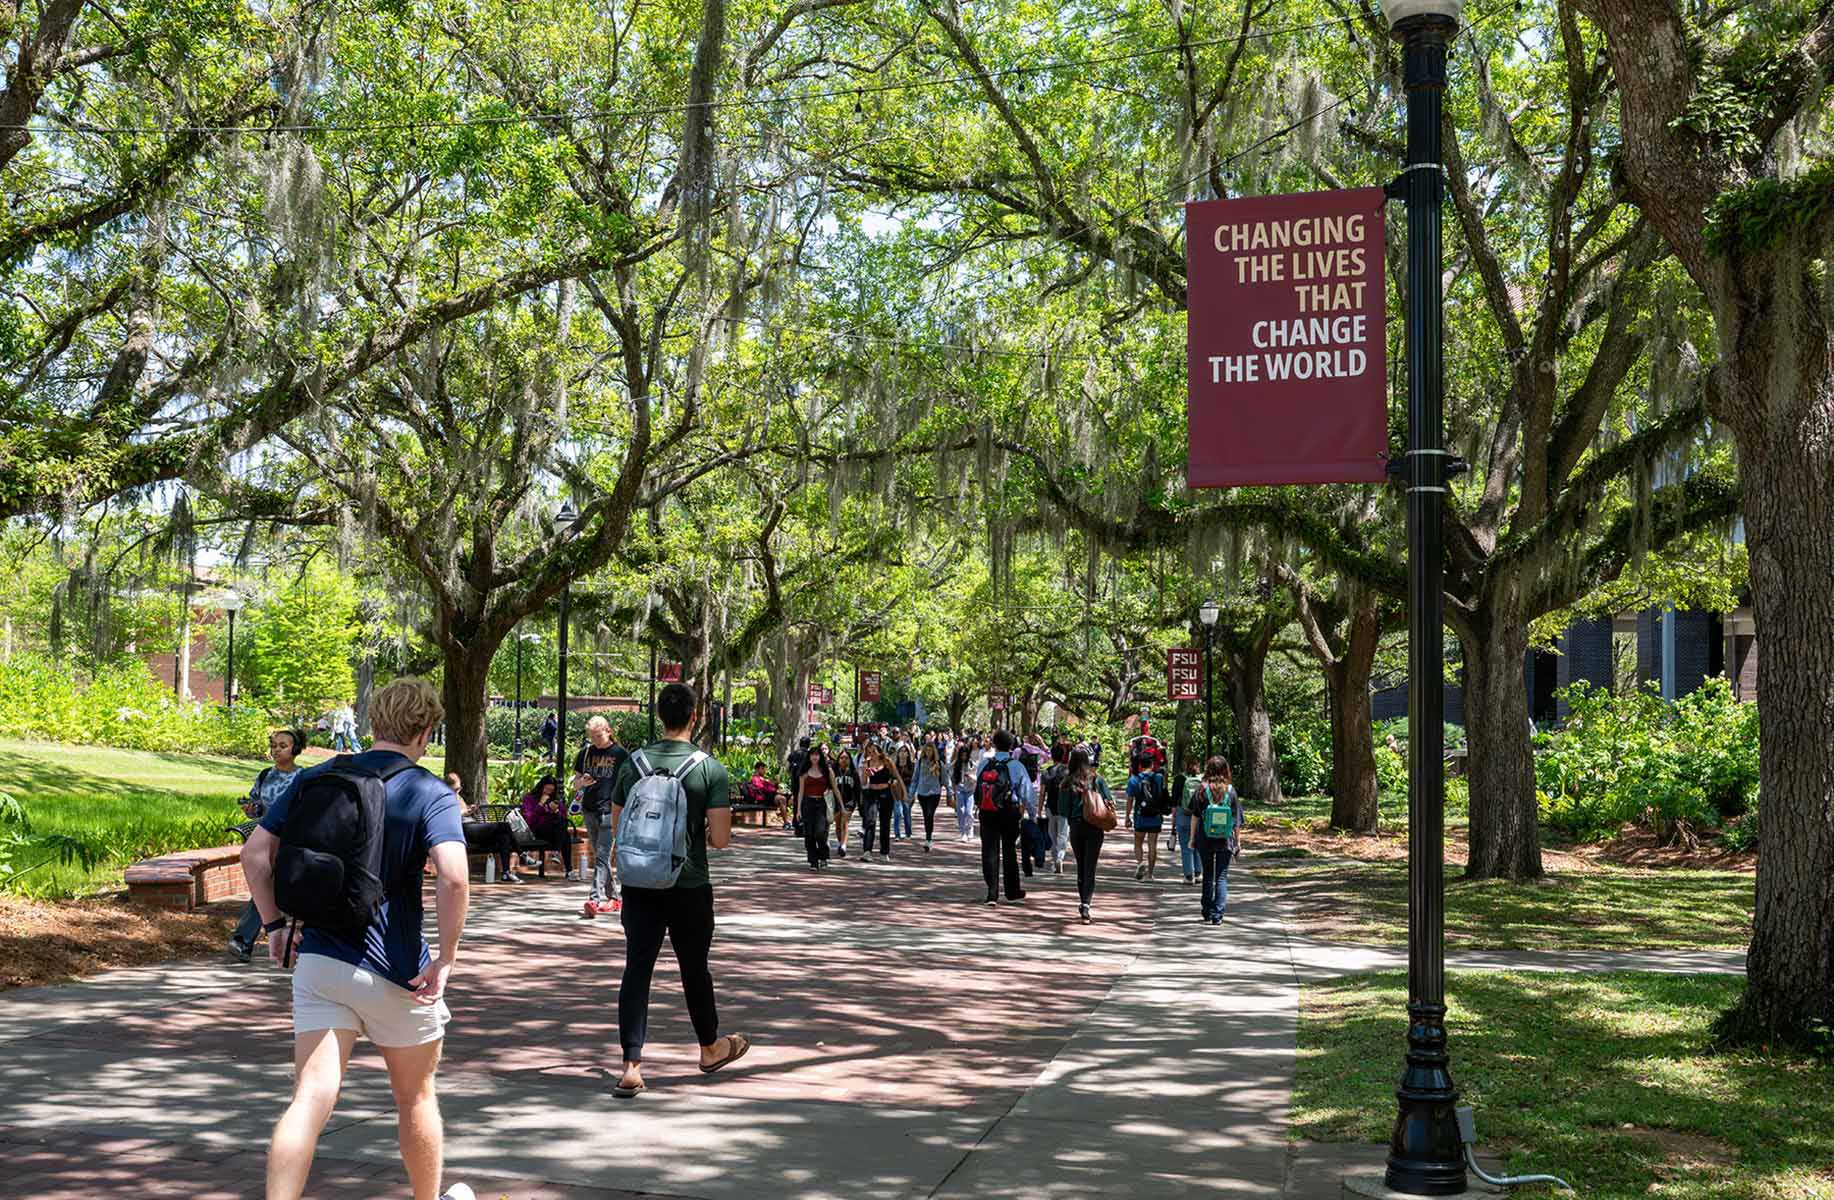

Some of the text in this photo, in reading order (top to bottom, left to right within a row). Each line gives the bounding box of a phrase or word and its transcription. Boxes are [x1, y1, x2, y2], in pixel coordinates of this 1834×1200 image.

[1214, 214, 1365, 252] CHANGING
[1234, 248, 1366, 284] THE LIVES
[1294, 281, 1367, 313] THAT
[1252, 315, 1367, 349] CHANGE
[1208, 349, 1367, 384] THE WORLD
[1172, 653, 1197, 665] FSU
[1172, 668, 1197, 680] FSU
[1172, 683, 1197, 695] FSU
